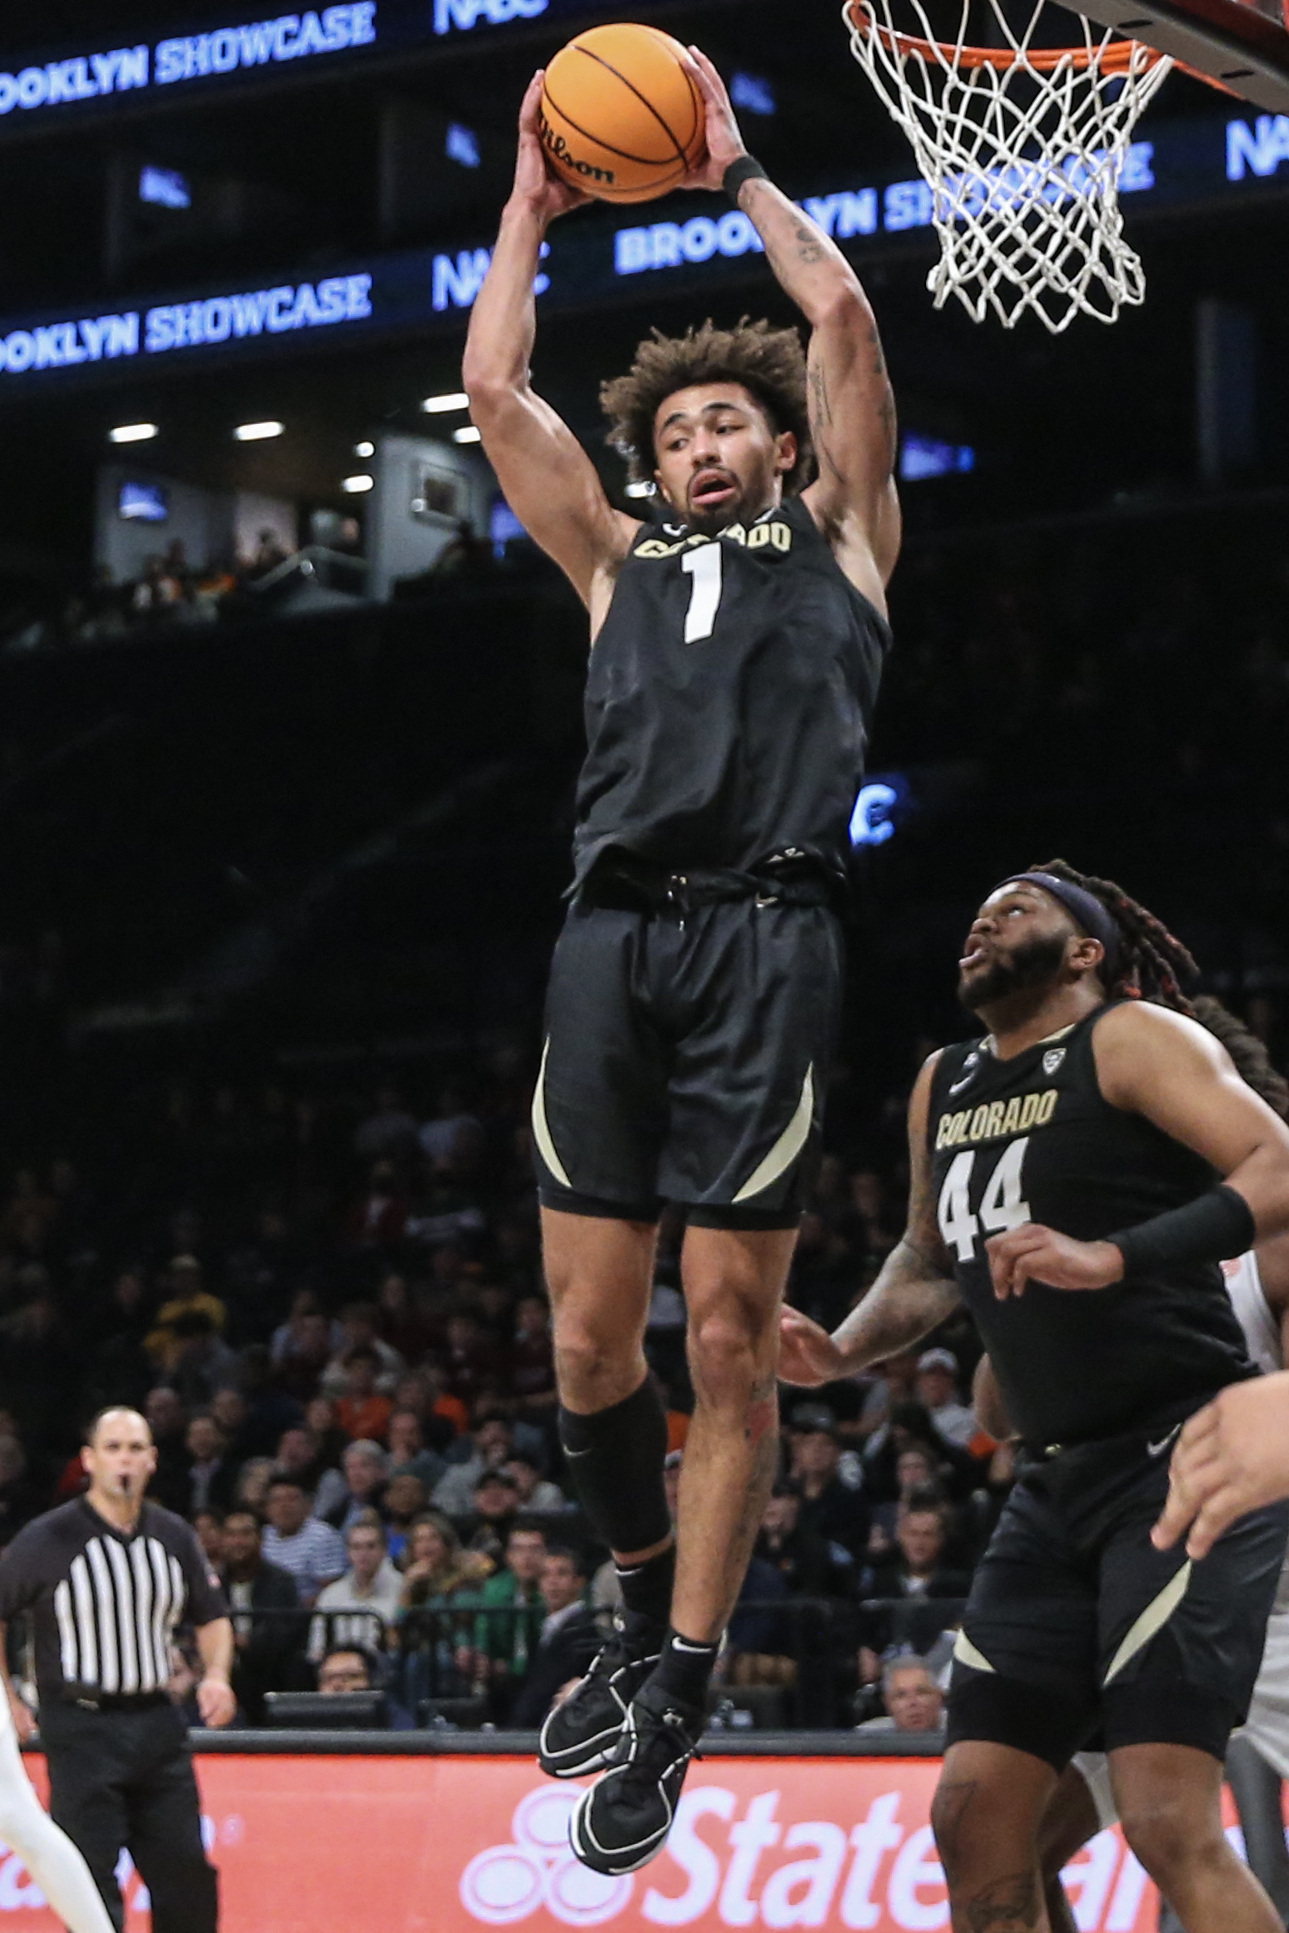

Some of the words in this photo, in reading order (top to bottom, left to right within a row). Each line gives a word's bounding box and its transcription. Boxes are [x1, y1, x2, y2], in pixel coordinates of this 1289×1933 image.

[154, 1, 377, 84] SHOWCASE
[614, 187, 877, 275] BROOYN
[0, 312, 139, 373] OKLYN
[145, 273, 373, 353] SHOWCASE
[681, 542, 722, 644] 1
[936, 1089, 1058, 1150] COLORADO
[937, 1136, 1031, 1262] 44
[641, 1785, 952, 1928] State
